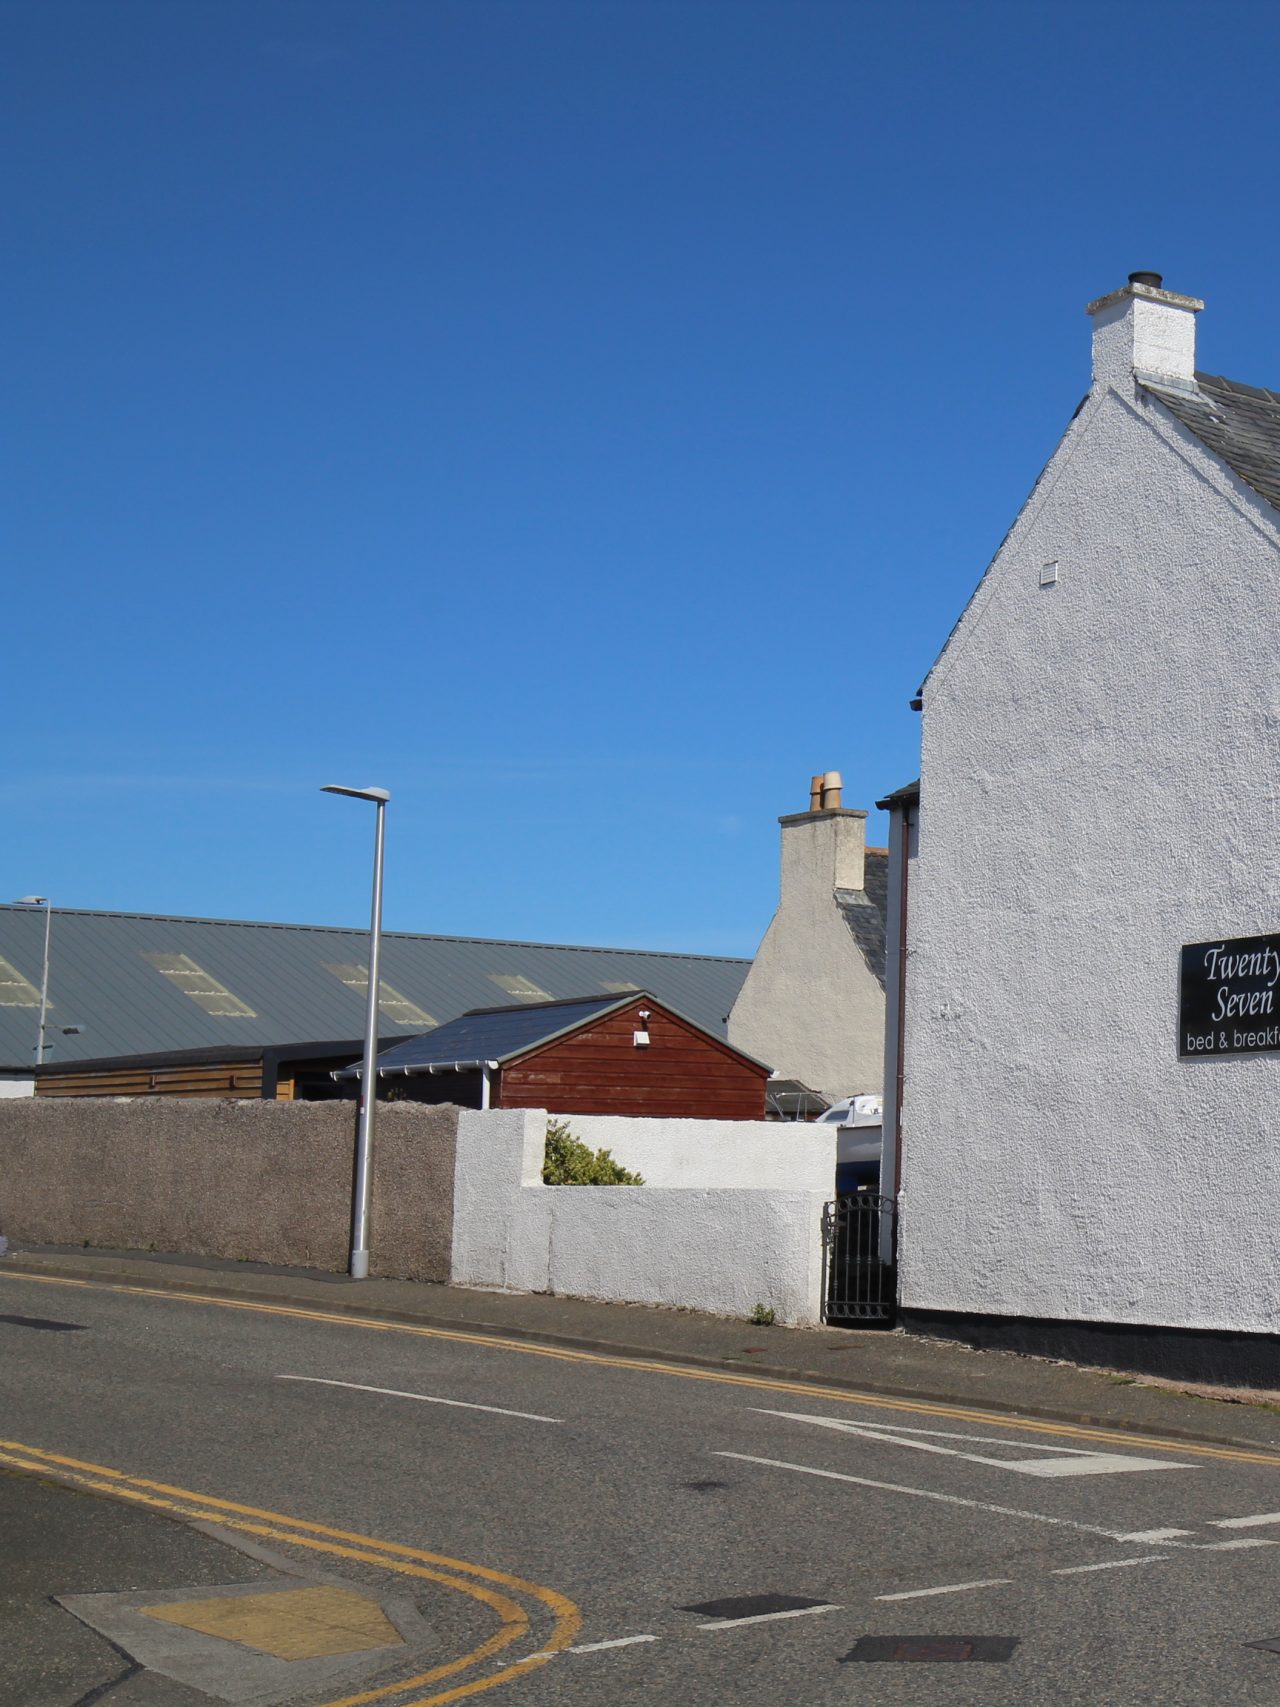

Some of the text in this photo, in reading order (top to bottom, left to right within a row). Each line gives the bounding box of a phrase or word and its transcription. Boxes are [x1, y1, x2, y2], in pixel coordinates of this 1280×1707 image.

[1211, 986, 1274, 1022] Seven
[1187, 1031, 1214, 1051] bed
[1218, 1031, 1228, 1049] &
